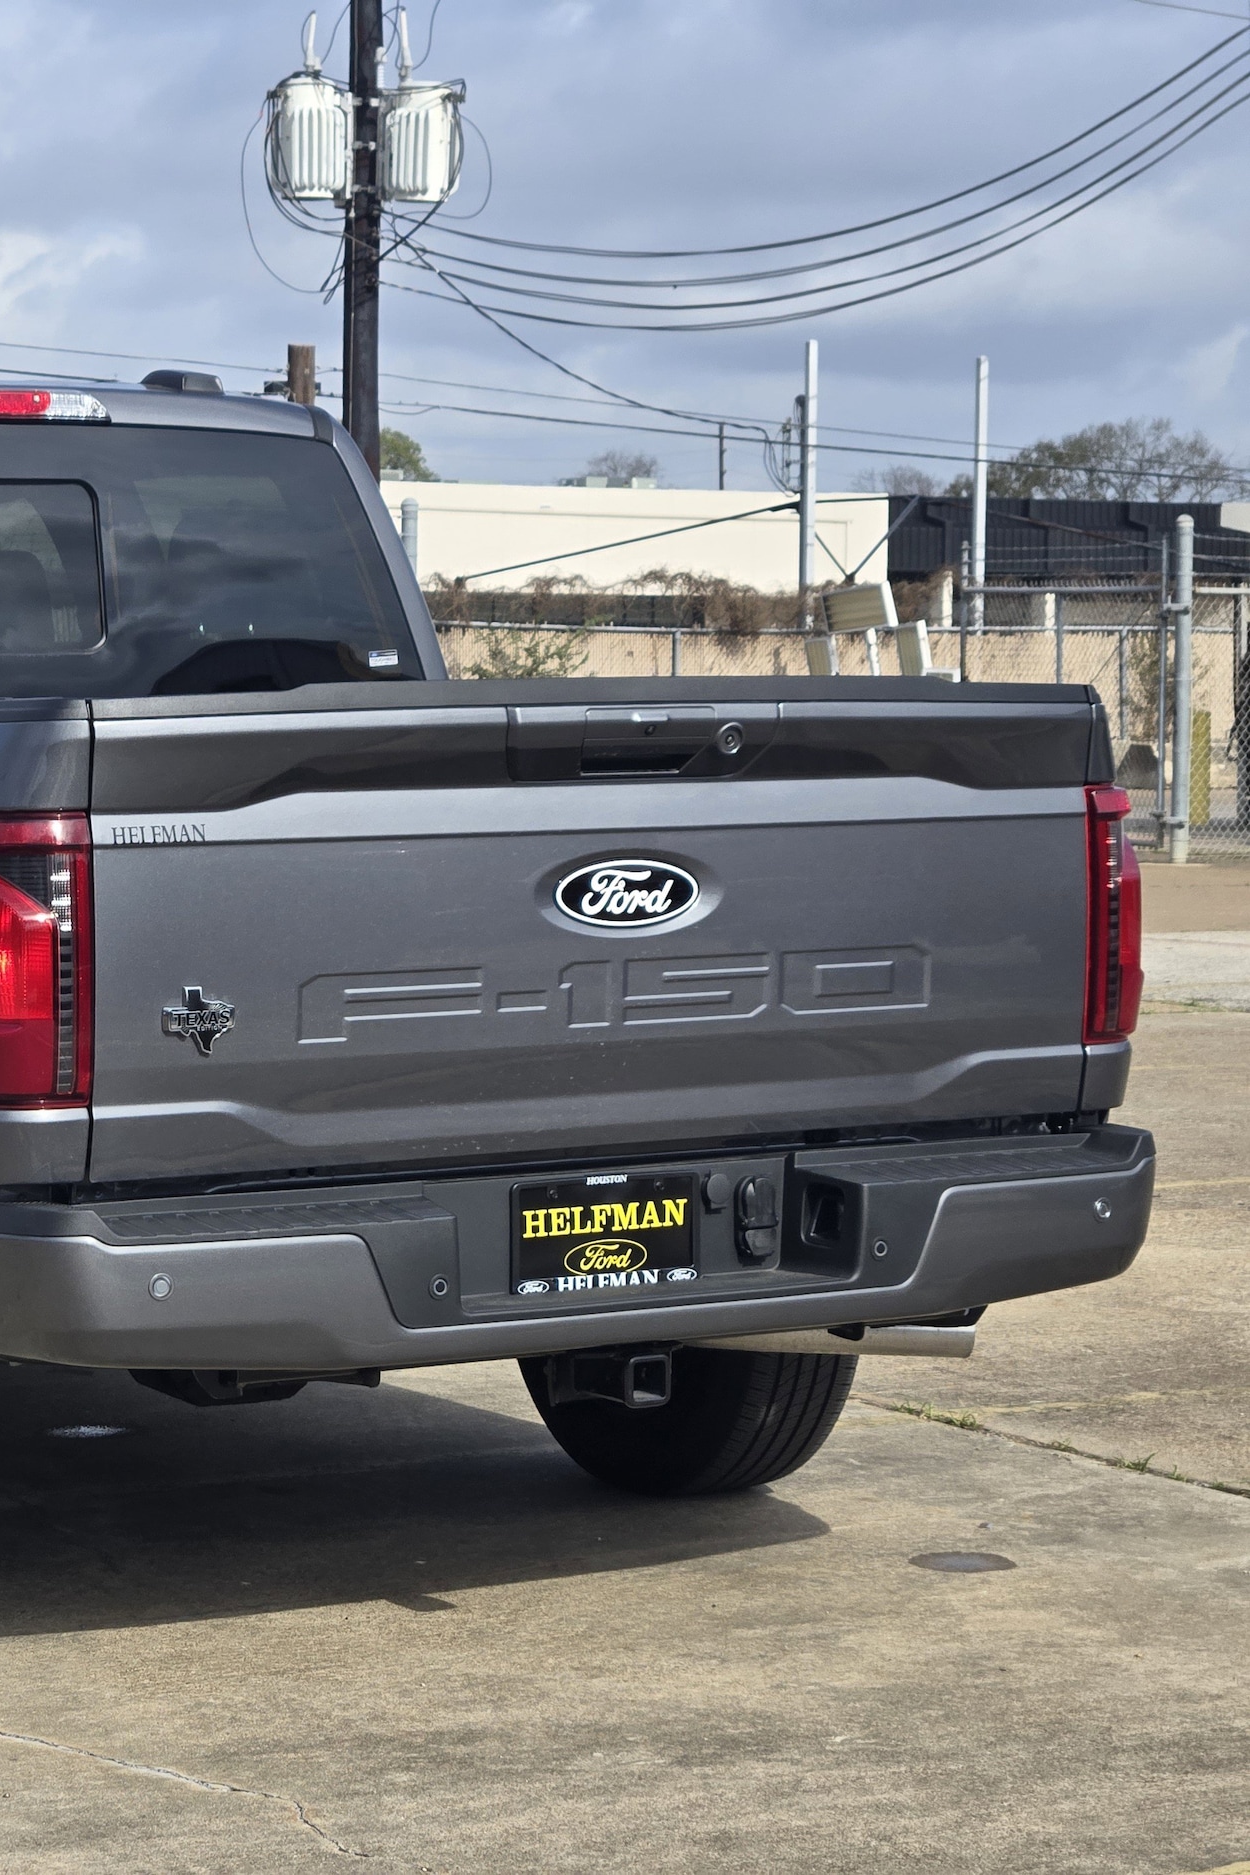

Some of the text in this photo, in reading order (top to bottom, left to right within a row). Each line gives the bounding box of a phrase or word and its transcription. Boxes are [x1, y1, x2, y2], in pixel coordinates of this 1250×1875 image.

[111, 823, 206, 845] HELFMAN
[581, 869, 674, 915] Ford
[297, 944, 932, 1044] F-150
[173, 1010, 230, 1027] TEXAS
[586, 1174, 628, 1186] HOUSTON
[522, 1198, 688, 1238] HELFMAN
[579, 1244, 632, 1271] Ford
